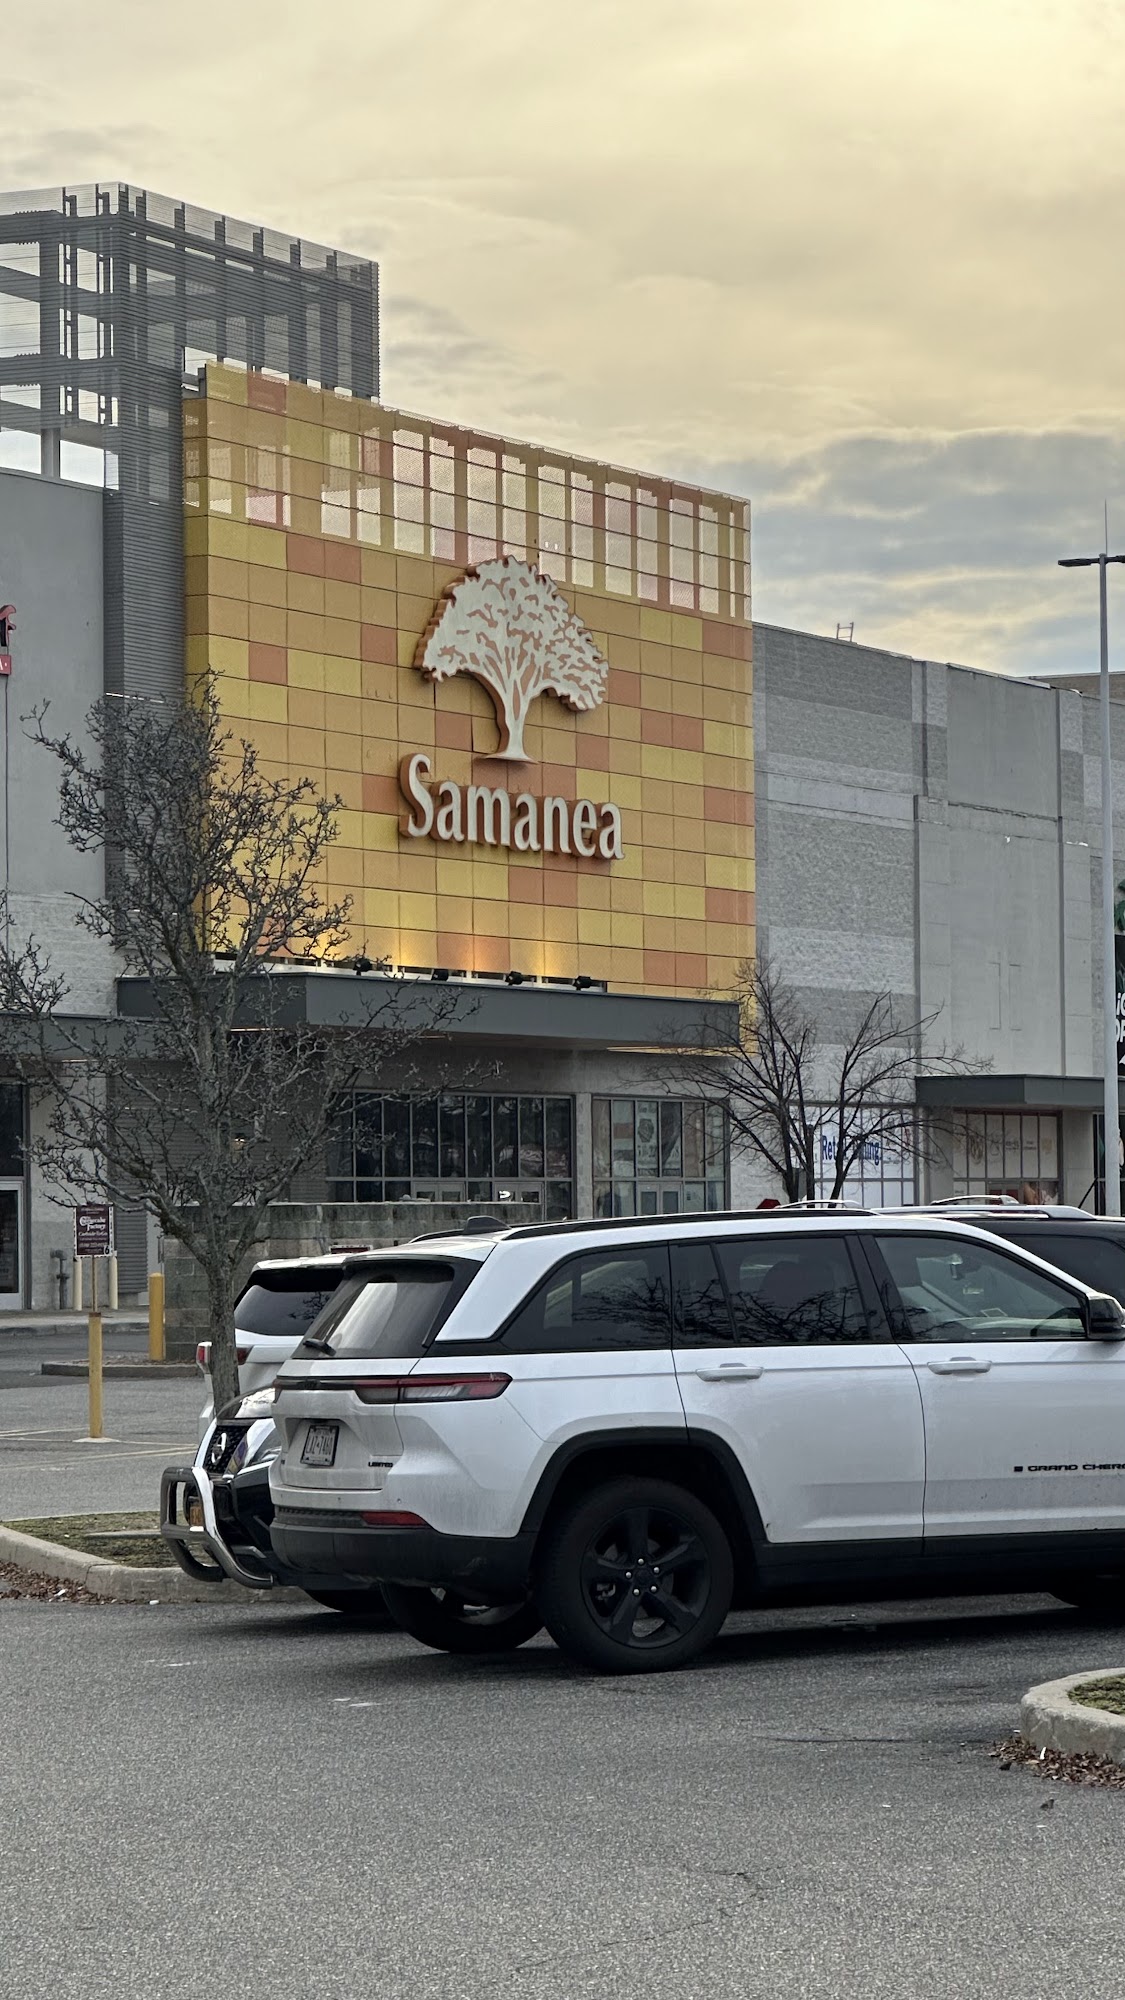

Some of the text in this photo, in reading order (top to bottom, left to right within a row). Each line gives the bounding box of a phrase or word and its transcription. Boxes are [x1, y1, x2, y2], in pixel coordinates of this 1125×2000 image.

[401, 753, 625, 860] Samanea
[105, 1246, 110, 1254] 6
[1027, 1464, 1078, 1472] GRAND
